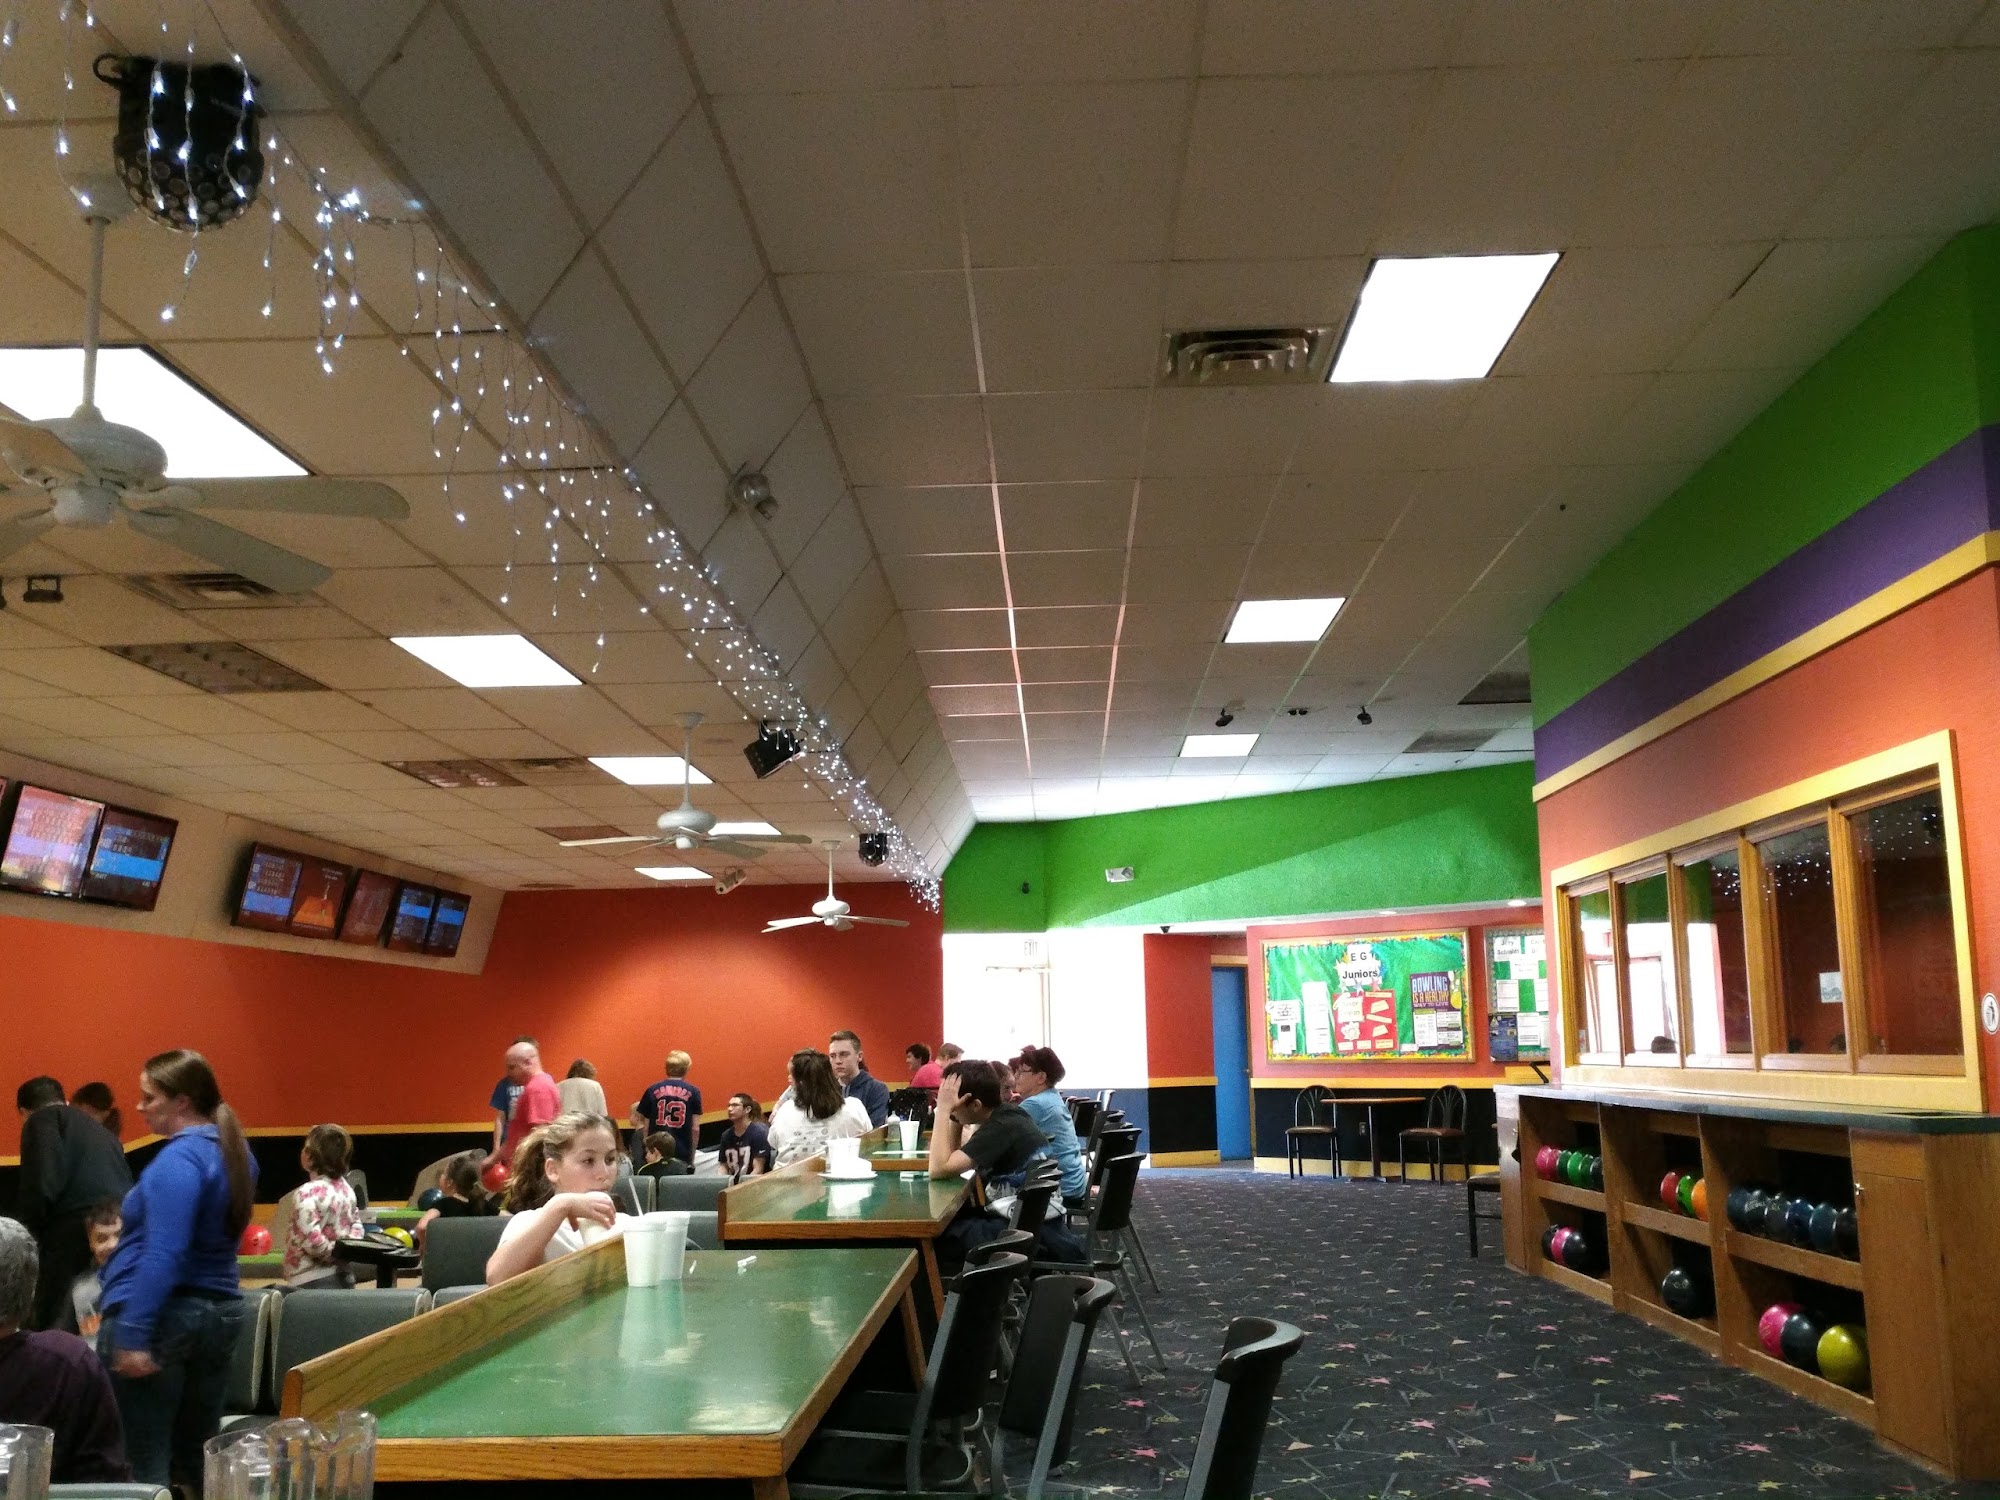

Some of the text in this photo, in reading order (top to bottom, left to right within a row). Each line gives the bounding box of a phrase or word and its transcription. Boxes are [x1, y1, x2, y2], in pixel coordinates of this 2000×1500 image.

[1351, 952, 1367, 961] E G
[1343, 970, 1378, 979] Juniors
[1412, 976, 1448, 992] BOWLING
[1413, 991, 1449, 1003] IS A HEALTHY
[656, 1099, 687, 1128] 13
[725, 1146, 751, 1176] 87
